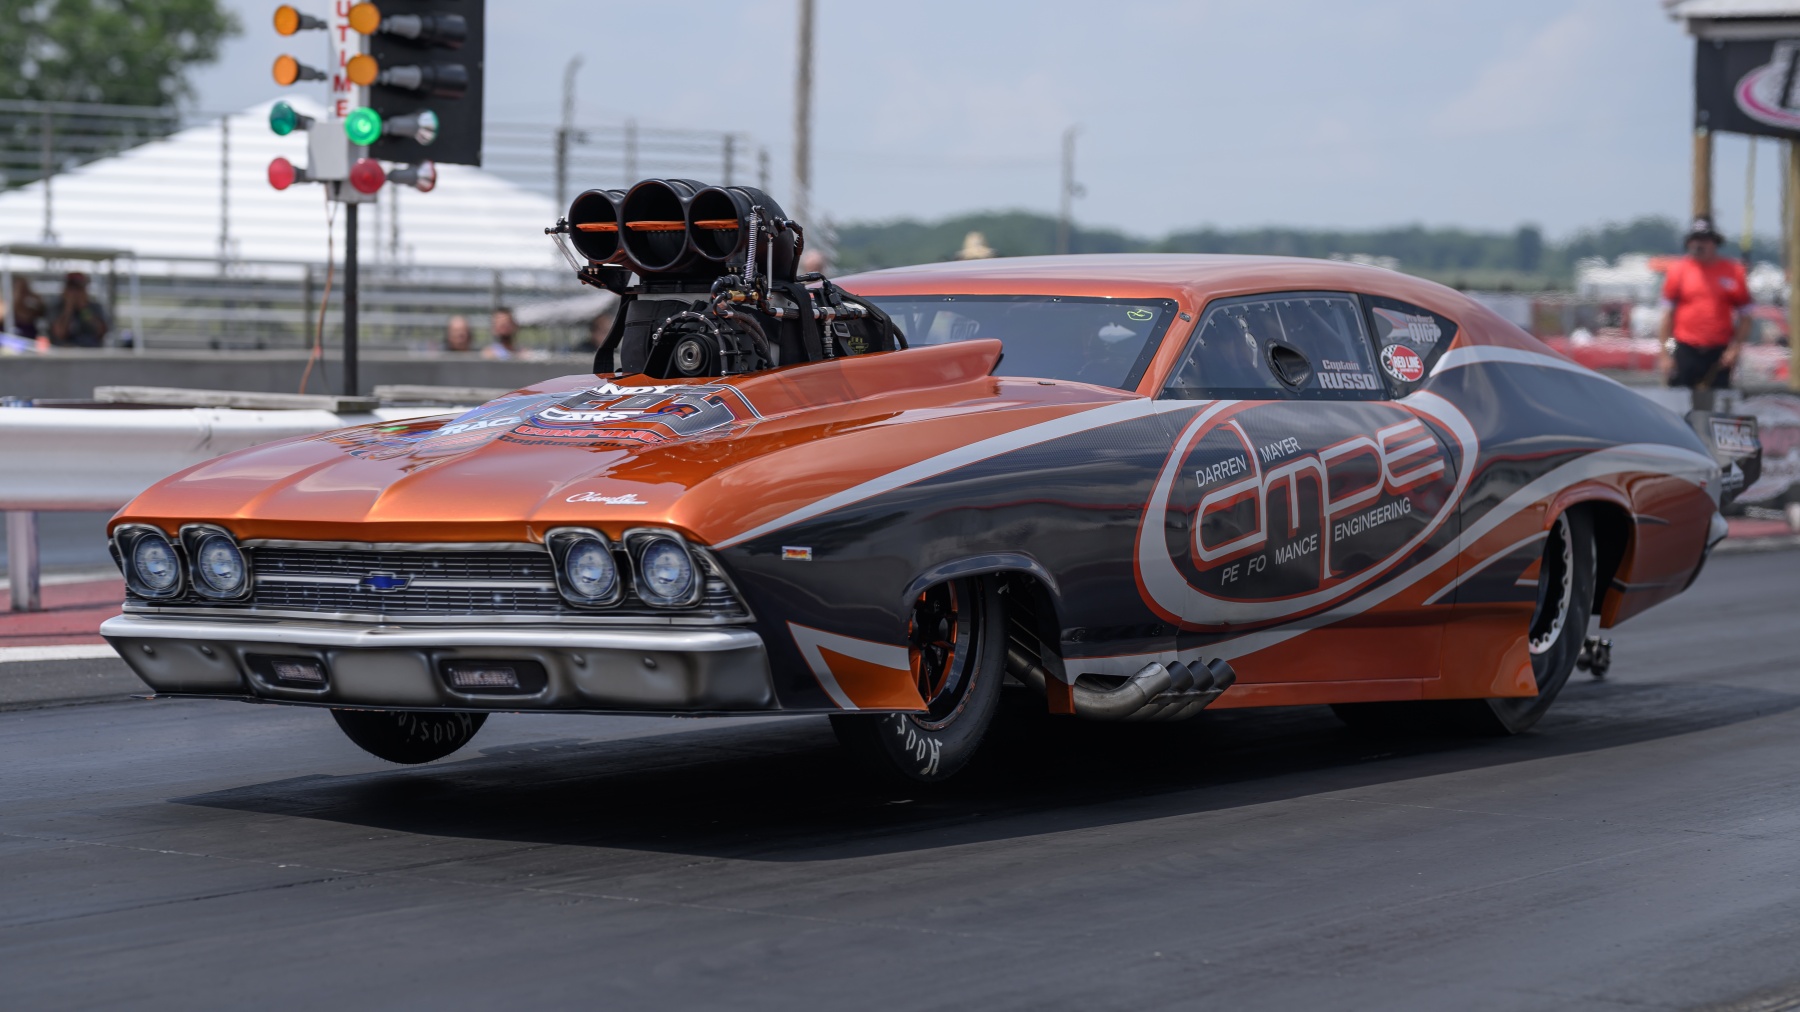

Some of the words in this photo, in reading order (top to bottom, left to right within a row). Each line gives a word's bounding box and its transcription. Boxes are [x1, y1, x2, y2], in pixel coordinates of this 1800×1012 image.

[1317, 372, 1377, 391] RUSSO
[1322, 359, 1360, 372] Captain
[1195, 454, 1247, 488] DARREN
[1260, 436, 1301, 464] MAYER
[1334, 497, 1412, 542] ENGINEERING
